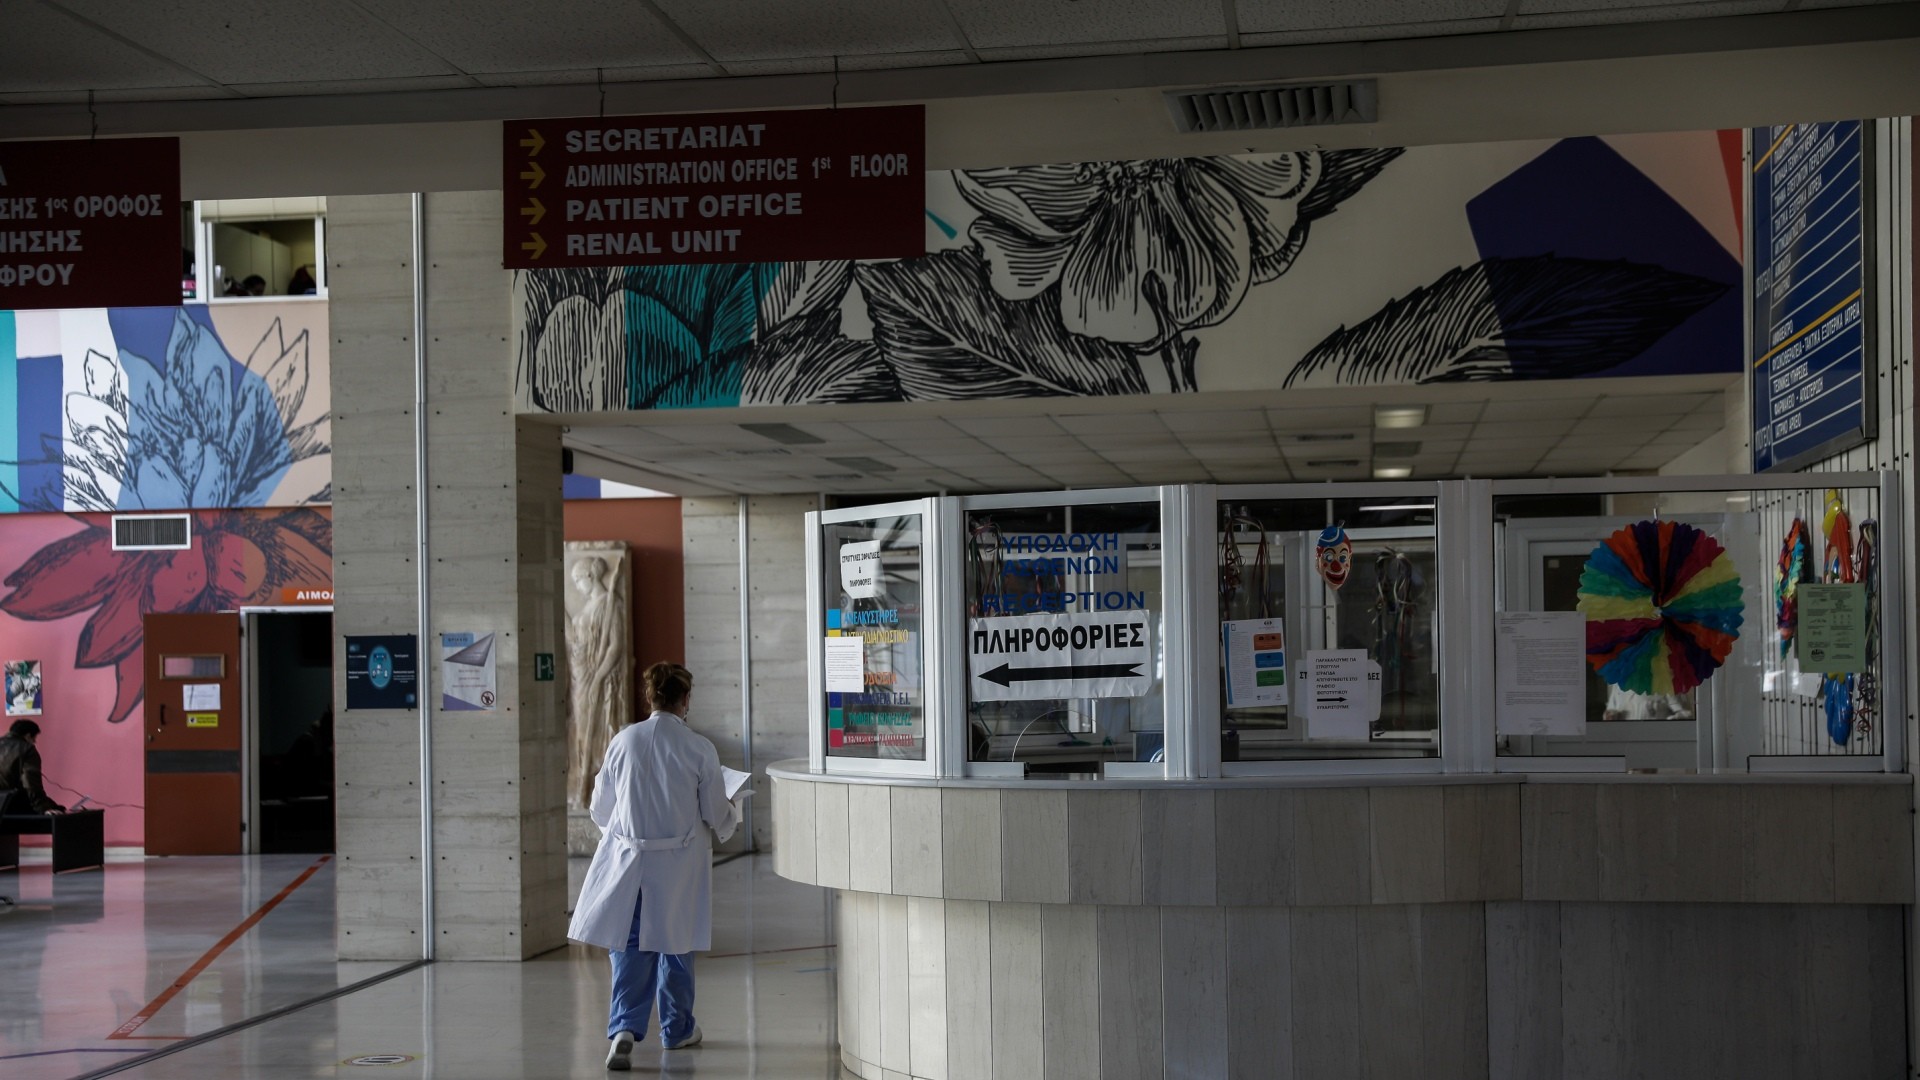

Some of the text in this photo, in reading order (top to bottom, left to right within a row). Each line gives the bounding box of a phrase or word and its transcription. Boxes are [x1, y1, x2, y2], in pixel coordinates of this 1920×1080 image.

[565, 124, 766, 153] SECRETARIAT
[565, 154, 908, 187] ADMINISTRATION OFFICE 1st FLOOR
[74, 194, 163, 218] ΟΡΟΦΟΣ
[567, 193, 802, 222] PATIENT OFFICE
[567, 229, 741, 256] RENAL UNIT
[1822, 313, 1842, 341] ΕΞΩΤΕΡΙΚΑ
[1844, 300, 1860, 326] ΙΑΤΡΕΙΑ
[1002, 533, 1118, 554] ΥΠΟΔΟΧΗ
[1002, 556, 1118, 576] ΑΣΘΕΝΩΝ
[982, 591, 1145, 613] RECEPTION
[844, 609, 899, 625] ΑΝΕΛΚΥΣΤΗΡΕΣ
[973, 623, 1144, 654] ΠΛΗΡΟΦΟΡΙΕΣ
